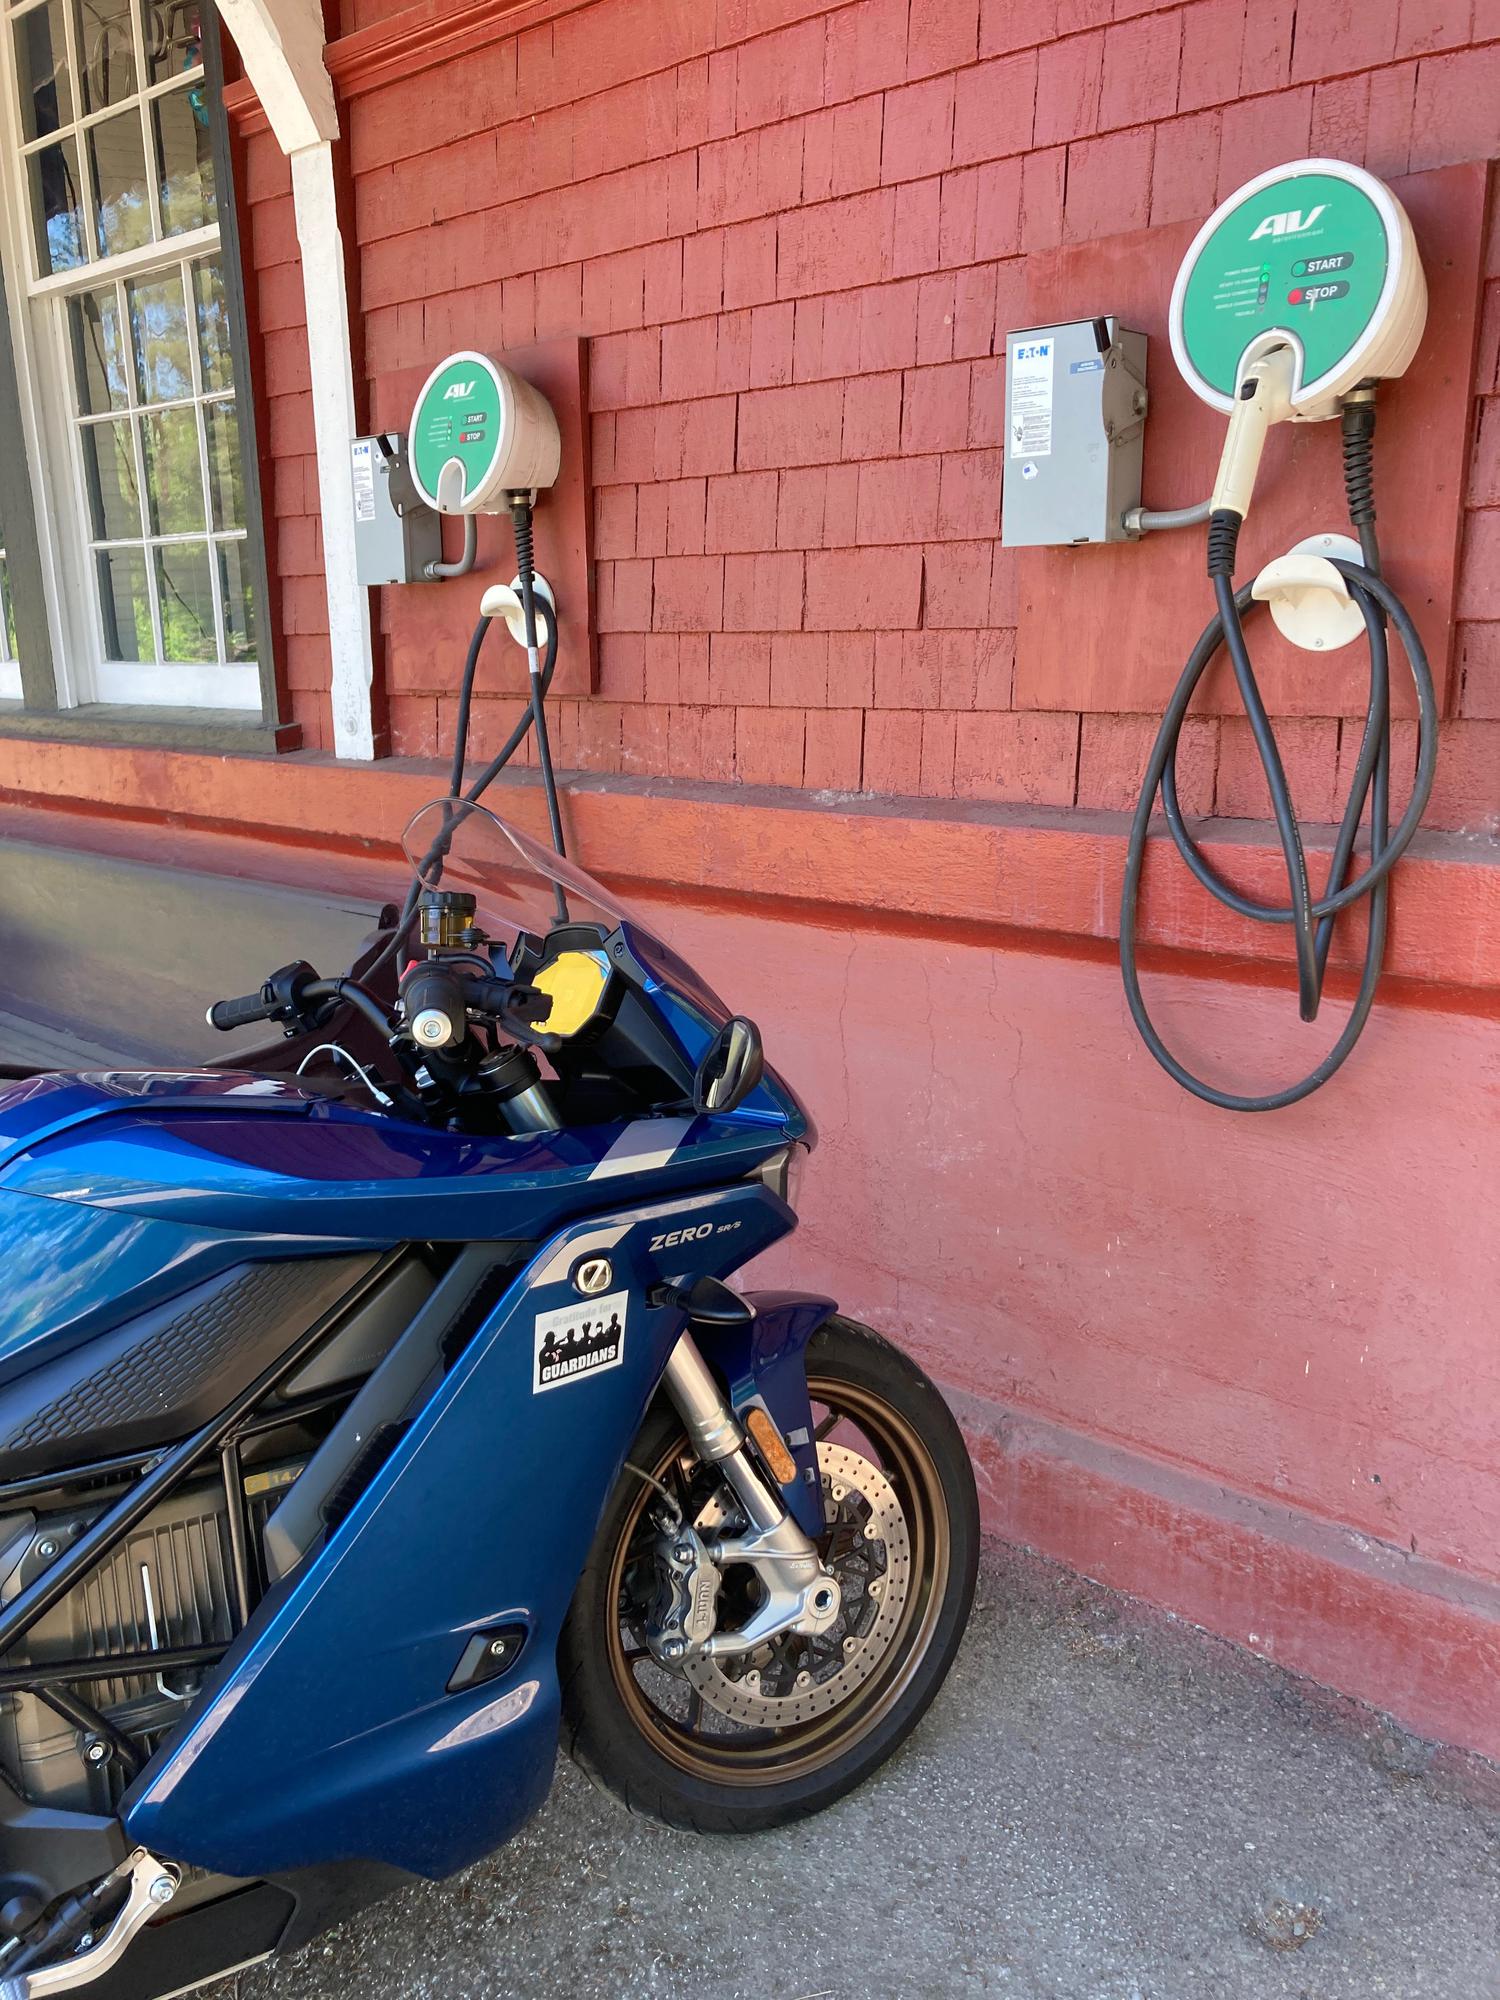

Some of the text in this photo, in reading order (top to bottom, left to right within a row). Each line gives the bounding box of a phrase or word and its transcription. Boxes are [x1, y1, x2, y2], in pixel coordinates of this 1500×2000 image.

[1307, 256, 1344, 272] START
[1305, 285, 1338, 300] STOP
[467, 414, 483, 423] START
[466, 432, 481, 441] STOP
[648, 1221, 742, 1253] ZERO SR/S
[541, 1344, 616, 1382] GUARDIANS
